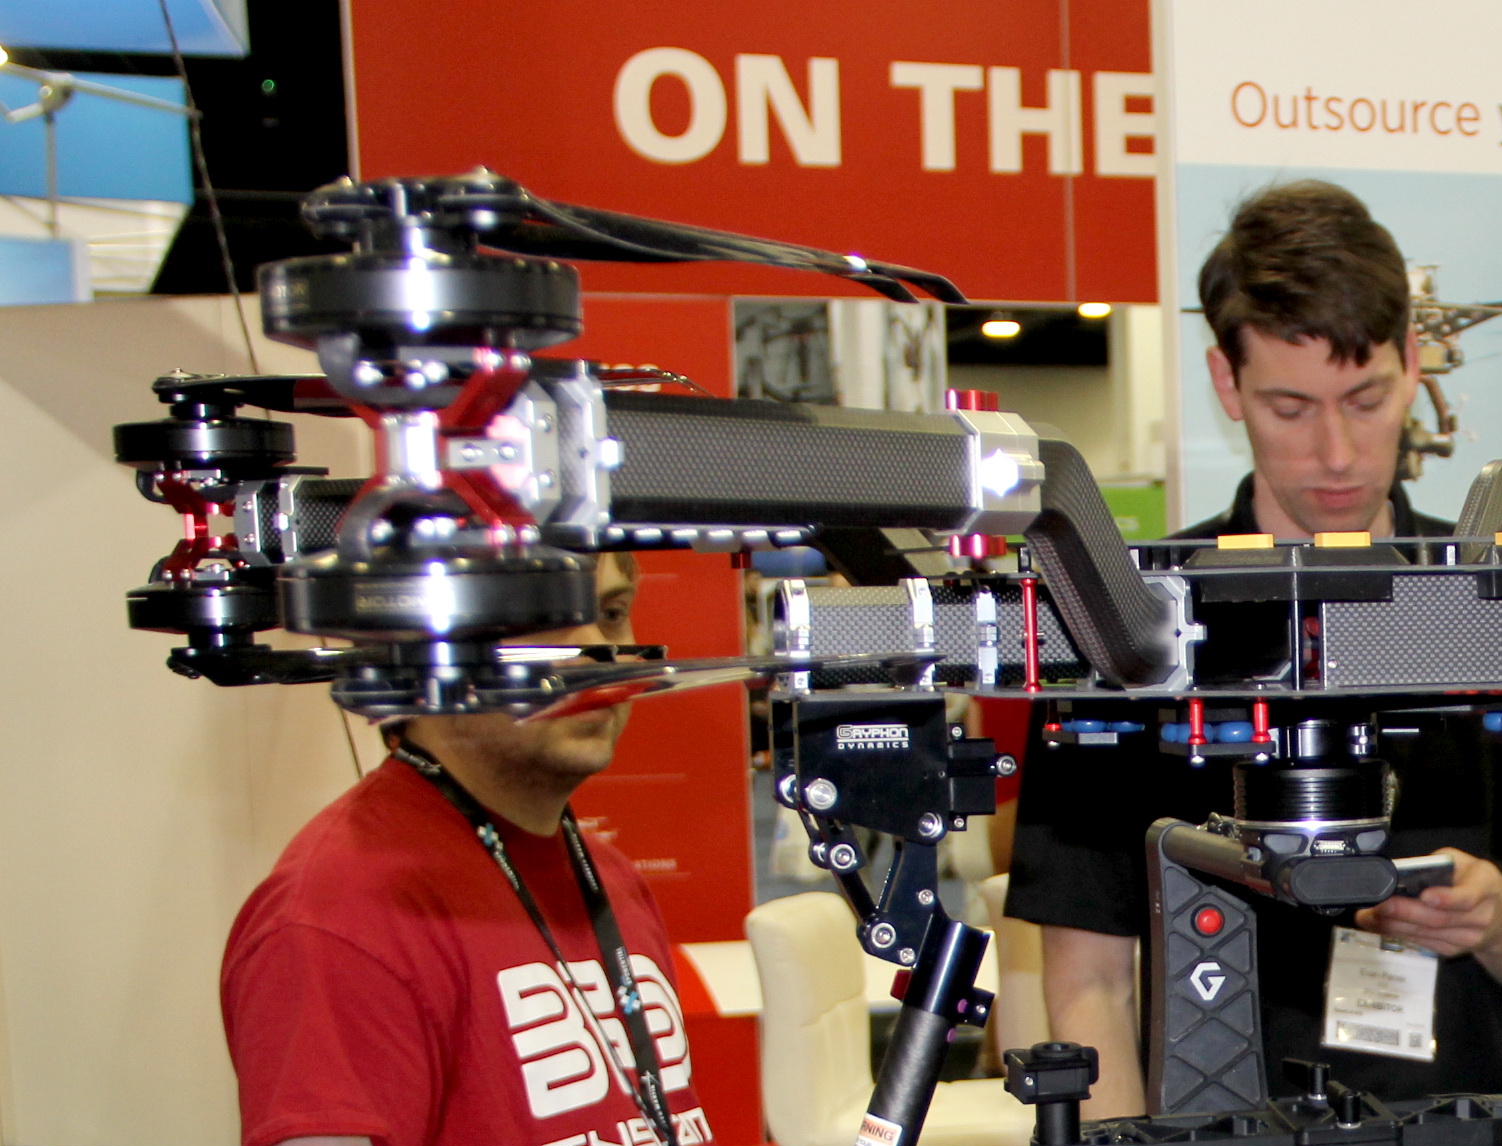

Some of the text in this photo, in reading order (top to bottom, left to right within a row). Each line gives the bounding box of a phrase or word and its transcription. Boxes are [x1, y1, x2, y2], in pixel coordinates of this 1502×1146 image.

[612, 46, 1157, 178] ON THE
[1230, 80, 1481, 137] Outsource
[837, 725, 909, 742] GRYPHON
[838, 742, 909, 750] DYNAMICS
